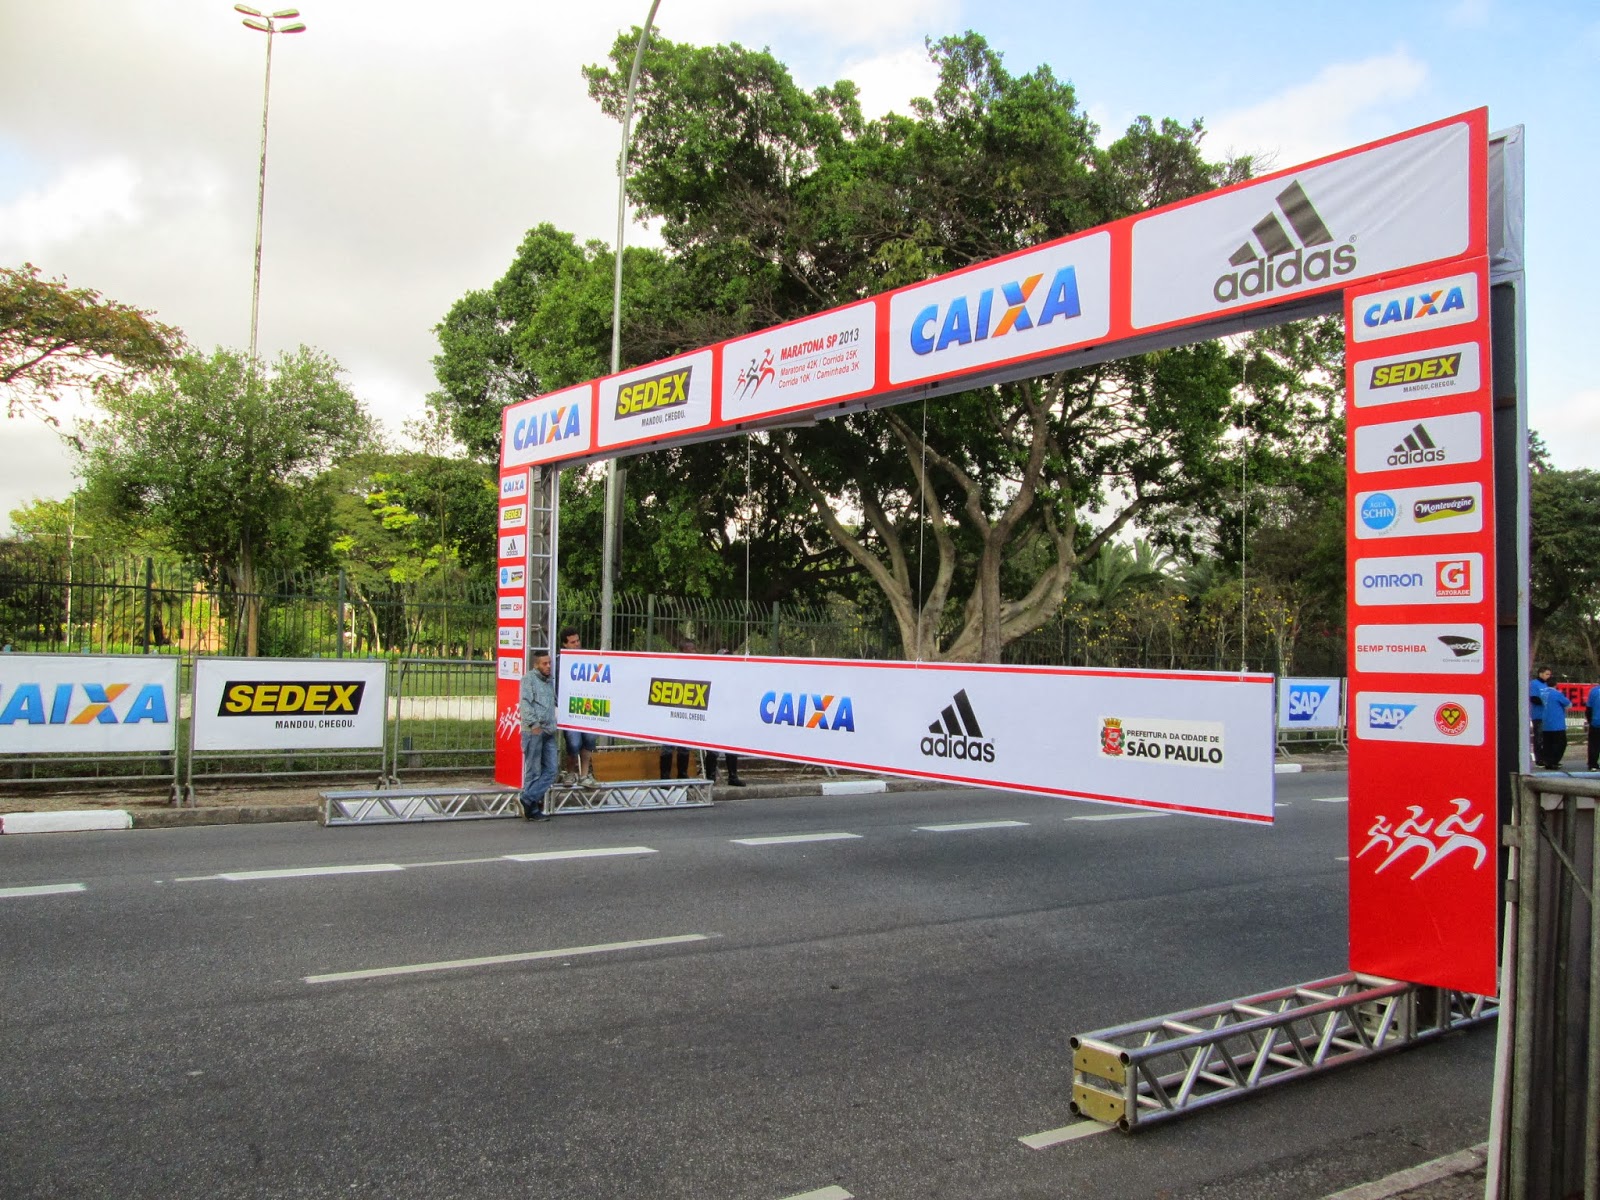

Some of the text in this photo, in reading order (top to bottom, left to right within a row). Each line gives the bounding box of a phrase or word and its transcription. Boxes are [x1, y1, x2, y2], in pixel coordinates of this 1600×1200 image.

[1213, 244, 1357, 303] adidas
[910, 265, 1081, 356] CAIXA
[1363, 286, 1465, 328] CAIXA
[780, 328, 860, 361] MARATONA SP 2013
[778, 377, 799, 389] Corrida
[800, 373, 811, 384] 10K
[816, 366, 850, 380] Caminhada
[851, 362, 860, 371] 3K
[780, 364, 806, 377] Maratona
[806, 360, 818, 370] 42K
[822, 354, 845, 366] Corrida
[845, 350, 858, 361] 25K
[1373, 356, 1457, 386] SEDEX
[618, 371, 689, 415] SEDEX
[513, 403, 581, 451] CAIXA
[1387, 448, 1446, 466] adidas
[1362, 508, 1395, 519] SCHIN
[1362, 573, 1423, 588] OMRON
[1386, 644, 1427, 653] TOSHIBA
[570, 662, 612, 684] CAIXA
[0, 683, 169, 725] AIXA
[225, 685, 359, 713] SEDEX
[568, 696, 611, 718] BRASIL
[650, 681, 708, 707] SEDEX
[1290, 691, 1321, 715] SAP
[275, 719, 356, 730] MANDOU, CHEGOU.
[759, 690, 855, 733] CAIXA
[1370, 707, 1405, 725] SAP
[920, 733, 995, 763] adidas
[1126, 730, 1167, 739] PREFEITURA
[1181, 734, 1208, 742] CIDADE
[1127, 738, 1223, 764] SÃO PAULO
